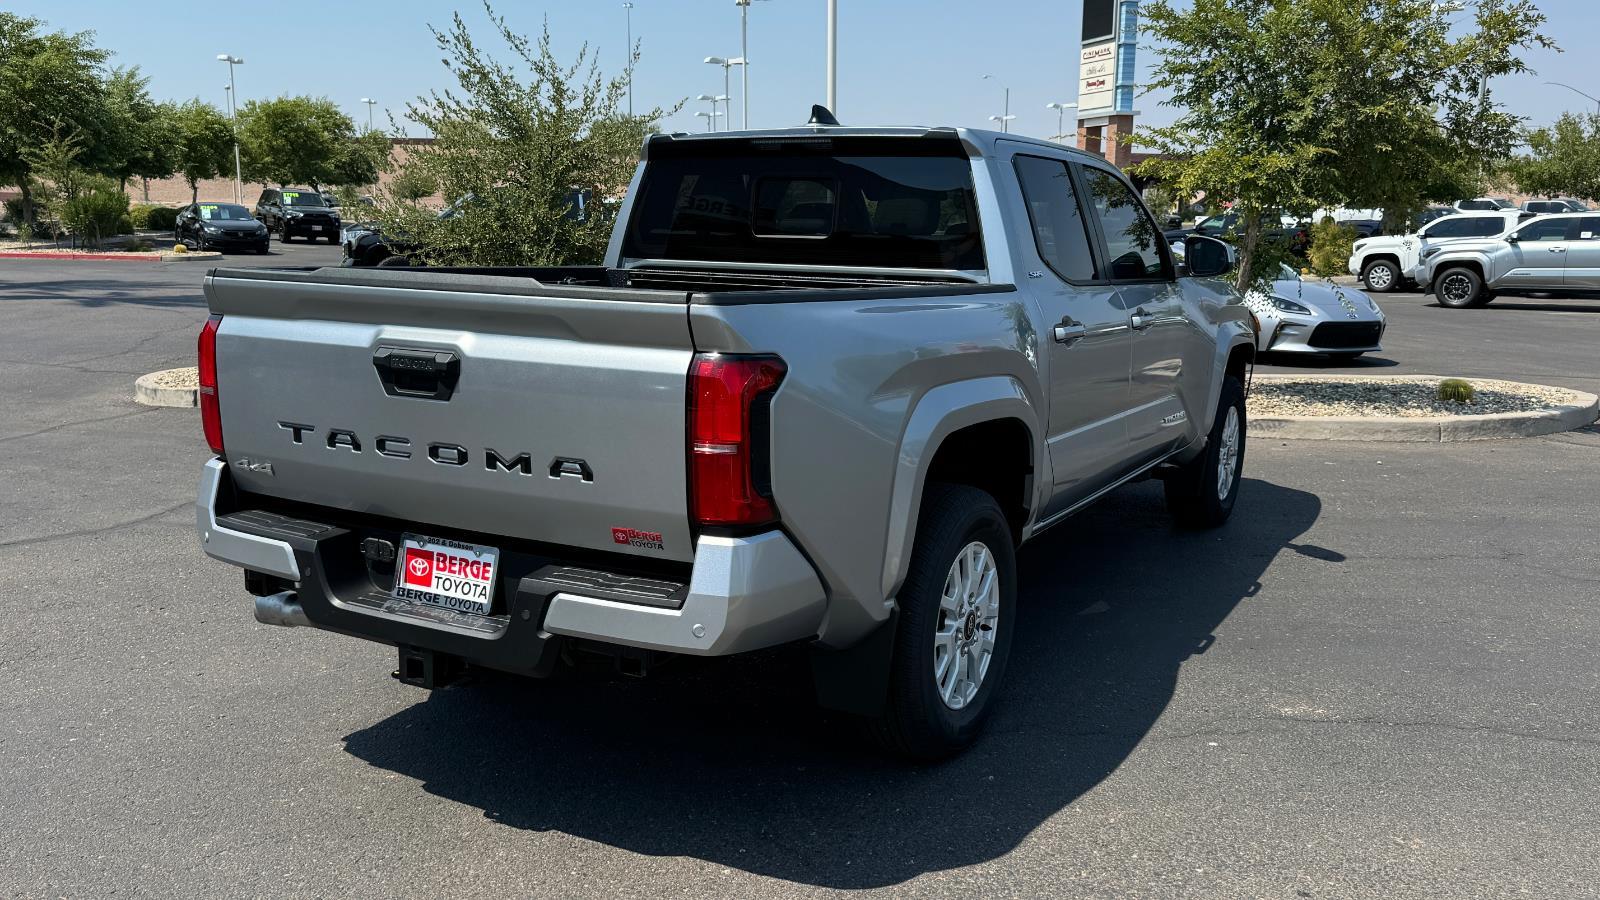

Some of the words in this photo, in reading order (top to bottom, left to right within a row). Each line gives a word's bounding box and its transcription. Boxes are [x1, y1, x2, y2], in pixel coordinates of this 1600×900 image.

[392, 358, 434, 371] TOYOTA
[277, 420, 594, 484] TACOMA
[427, 537, 439, 545] 202
[449, 540, 474, 551] Dobson
[628, 529, 663, 542] BERGE
[631, 540, 665, 551] TOYOTA
[435, 552, 492, 581] BERGE
[434, 576, 488, 600] TOYOTA
[396, 587, 440, 604] BERGE
[443, 595, 485, 613] TOYOTA
